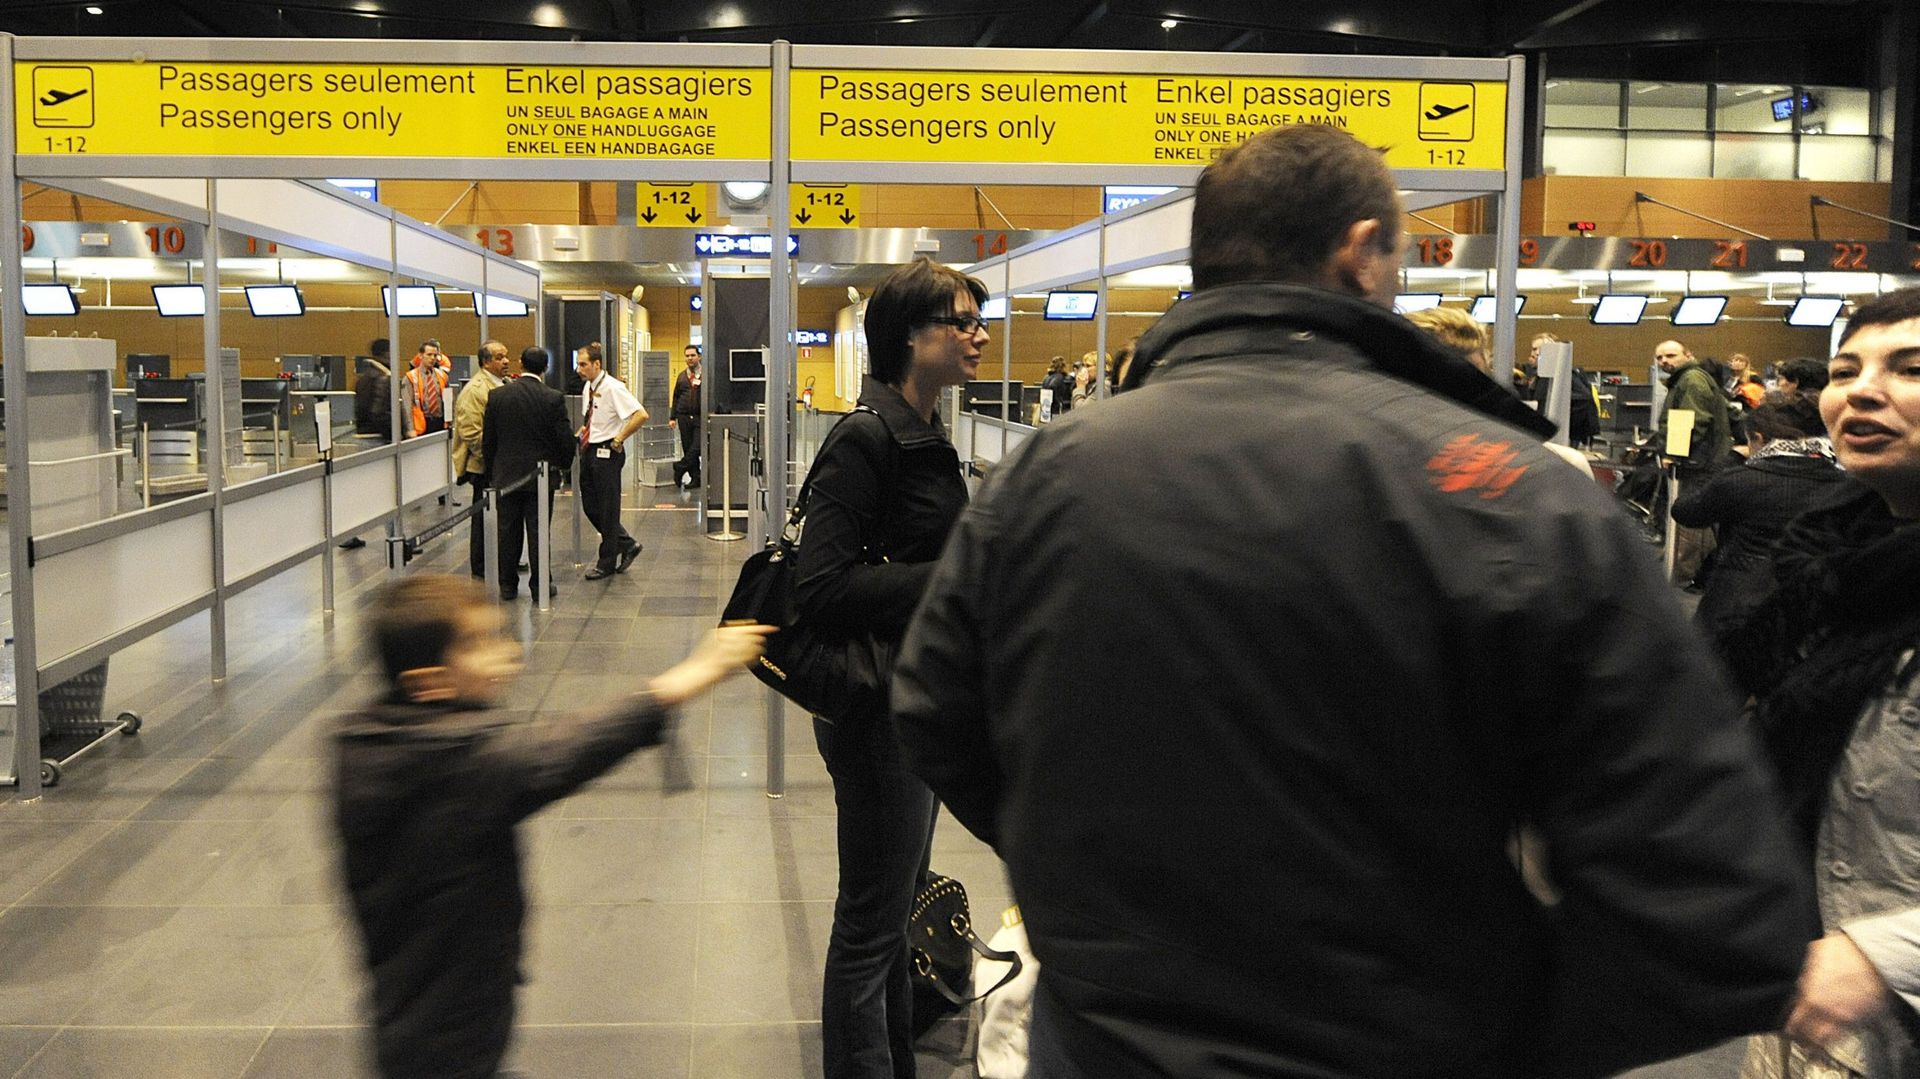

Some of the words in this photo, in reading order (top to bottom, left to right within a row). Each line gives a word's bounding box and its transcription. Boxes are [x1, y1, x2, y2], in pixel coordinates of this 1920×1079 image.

[159, 65, 313, 98] Passagers
[323, 68, 476, 94] seulement
[505, 68, 586, 94] Enkel
[596, 70, 753, 102] passagiers
[819, 75, 971, 107] Passagers
[981, 77, 1128, 104] seulement
[1156, 78, 1233, 104] Enkel
[1243, 82, 1392, 112] passagiers
[160, 103, 332, 136] Passengers
[342, 105, 402, 136] only
[506, 105, 528, 118] UN
[534, 105, 576, 119] SEUL
[580, 106, 649, 119] BAGAGE
[653, 107, 664, 120] A
[669, 107, 708, 120] MAIN
[1155, 112, 1176, 125] UN
[1181, 112, 1221, 126] SEUL
[1226, 113, 1291, 126] BAGAGE
[1296, 114, 1305, 125] A
[1310, 115, 1348, 128] MAIN
[506, 123, 548, 136] ONLY
[553, 123, 587, 137] ONE
[592, 124, 716, 138] HANDLUGGAGE
[819, 111, 988, 144] Passengers
[998, 113, 1056, 145] only
[1154, 129, 1195, 142] ONLY
[1199, 130, 1231, 143] ONE
[44, 136, 87, 153] 1-12
[507, 141, 560, 154] ENKEL
[564, 141, 596, 155] EEN
[601, 142, 715, 155] HANDBAGAGE
[1154, 147, 1204, 160] ENKEL
[1428, 149, 1466, 165] 1-12
[652, 190, 691, 205] 1-12
[806, 191, 845, 206] 1-12
[145, 226, 185, 253] 10
[475, 228, 514, 256] 13
[971, 232, 1008, 260] 14
[1417, 237, 1454, 265] 18
[1629, 240, 1667, 267] 20
[1710, 239, 1748, 268] 21
[1831, 242, 1868, 270] 22
